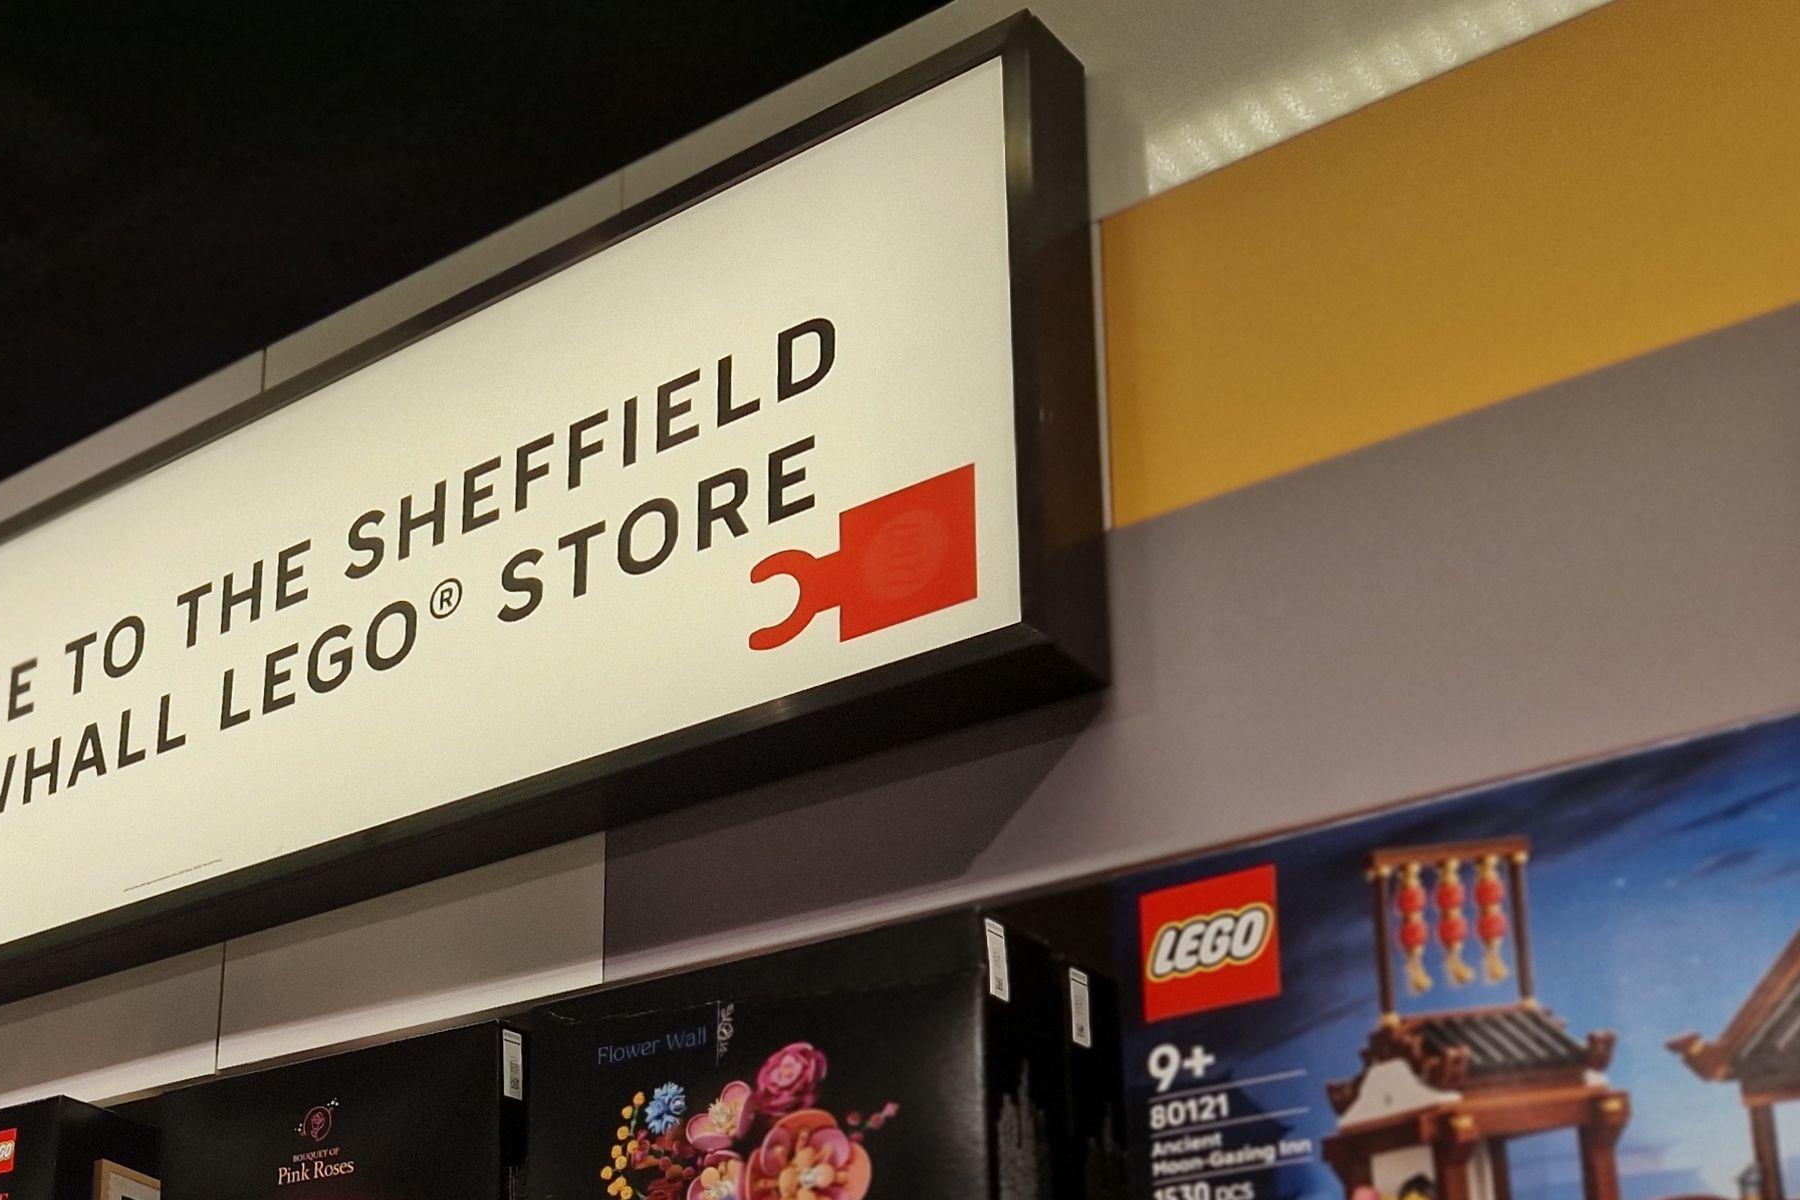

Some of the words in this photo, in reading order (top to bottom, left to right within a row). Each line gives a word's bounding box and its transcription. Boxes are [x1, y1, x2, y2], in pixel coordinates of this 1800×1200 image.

[66, 616, 144, 694] TO
[178, 540, 310, 648] THE
[345, 318, 835, 578] SHEFFIELD
[220, 579, 462, 730] LEGO®
[498, 436, 814, 623] STORE
[1148, 904, 1271, 980] LEGO
[597, 1039, 660, 1065] Flower
[666, 1026, 706, 1050] Wall
[1148, 1043, 1215, 1092] 9+
[1150, 1093, 1229, 1130] 80121
[293, 1148, 328, 1162] BOUQUET
[328, 1147, 340, 1156] OF
[1152, 1132, 1222, 1157] Ancient
[1152, 1145, 1277, 1177] Moon-Gazing
[1278, 1139, 1313, 1156] Inn
[278, 1162, 309, 1185] Pink
[313, 1161, 354, 1179] Roses
